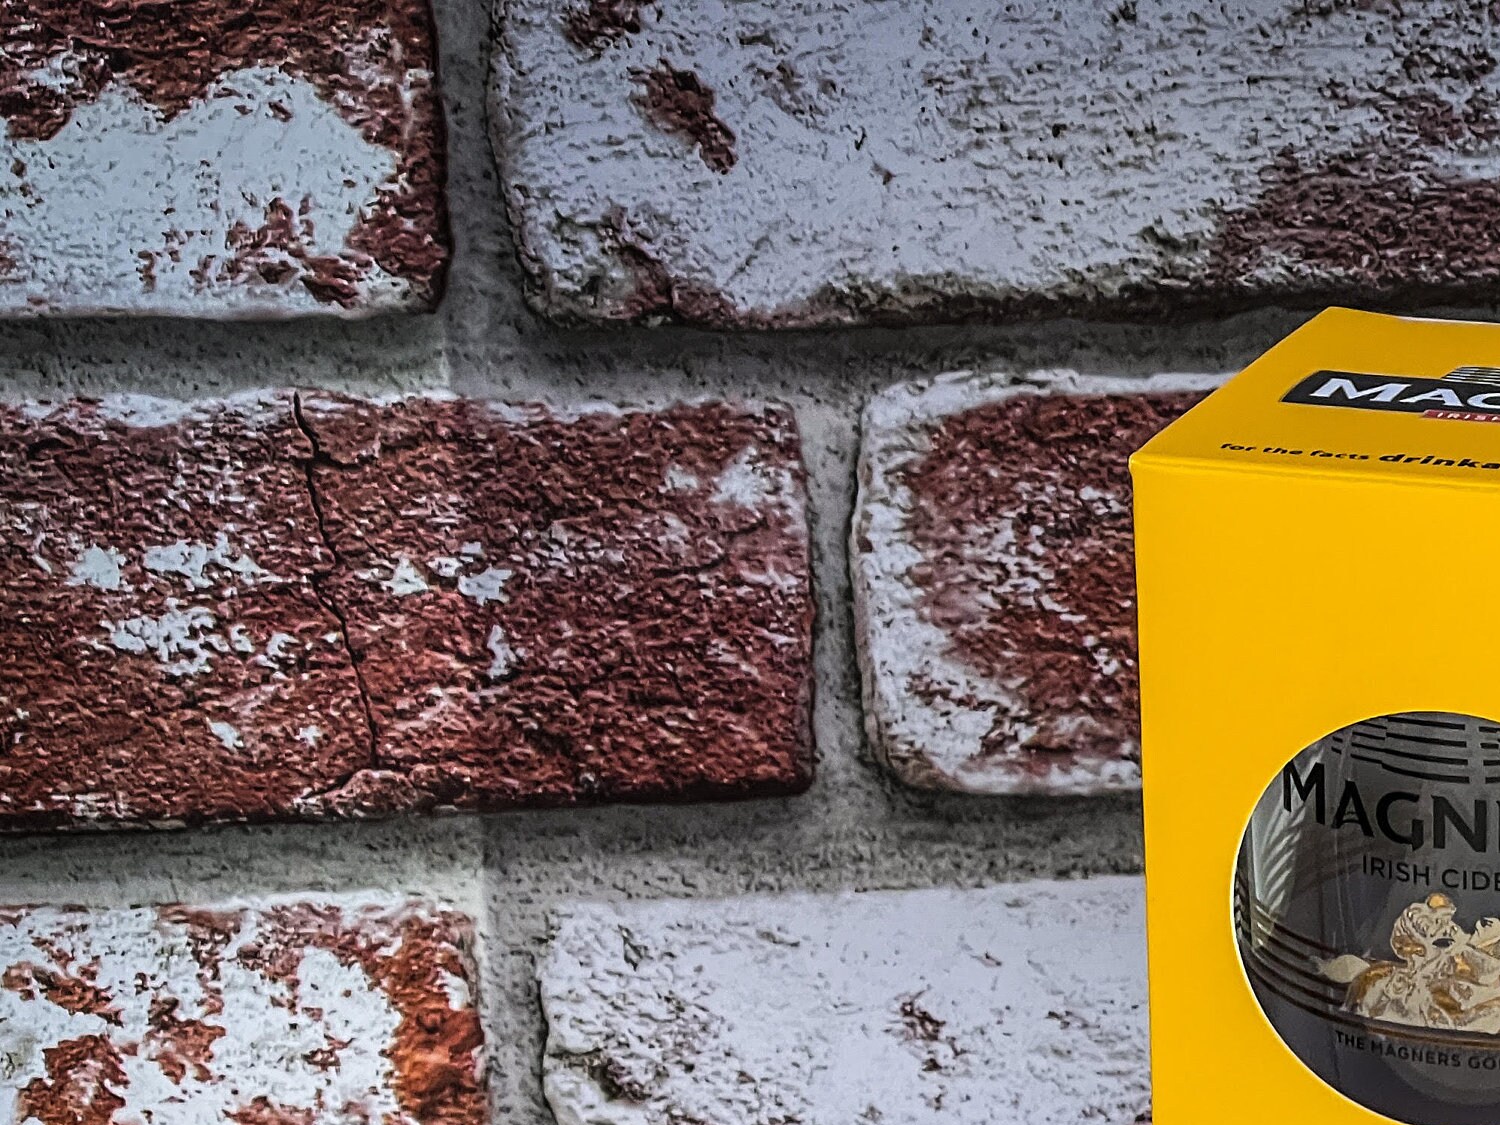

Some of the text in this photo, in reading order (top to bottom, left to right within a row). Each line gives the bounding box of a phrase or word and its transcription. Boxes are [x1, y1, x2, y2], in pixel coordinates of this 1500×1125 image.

[1220, 443, 1257, 452] for
[1263, 447, 1303, 456] the
[1310, 450, 1369, 460] facts
[1363, 855, 1430, 888] IRISH
[1335, 1030, 1365, 1049] THE
[1371, 1040, 1461, 1068] MAGNERS
